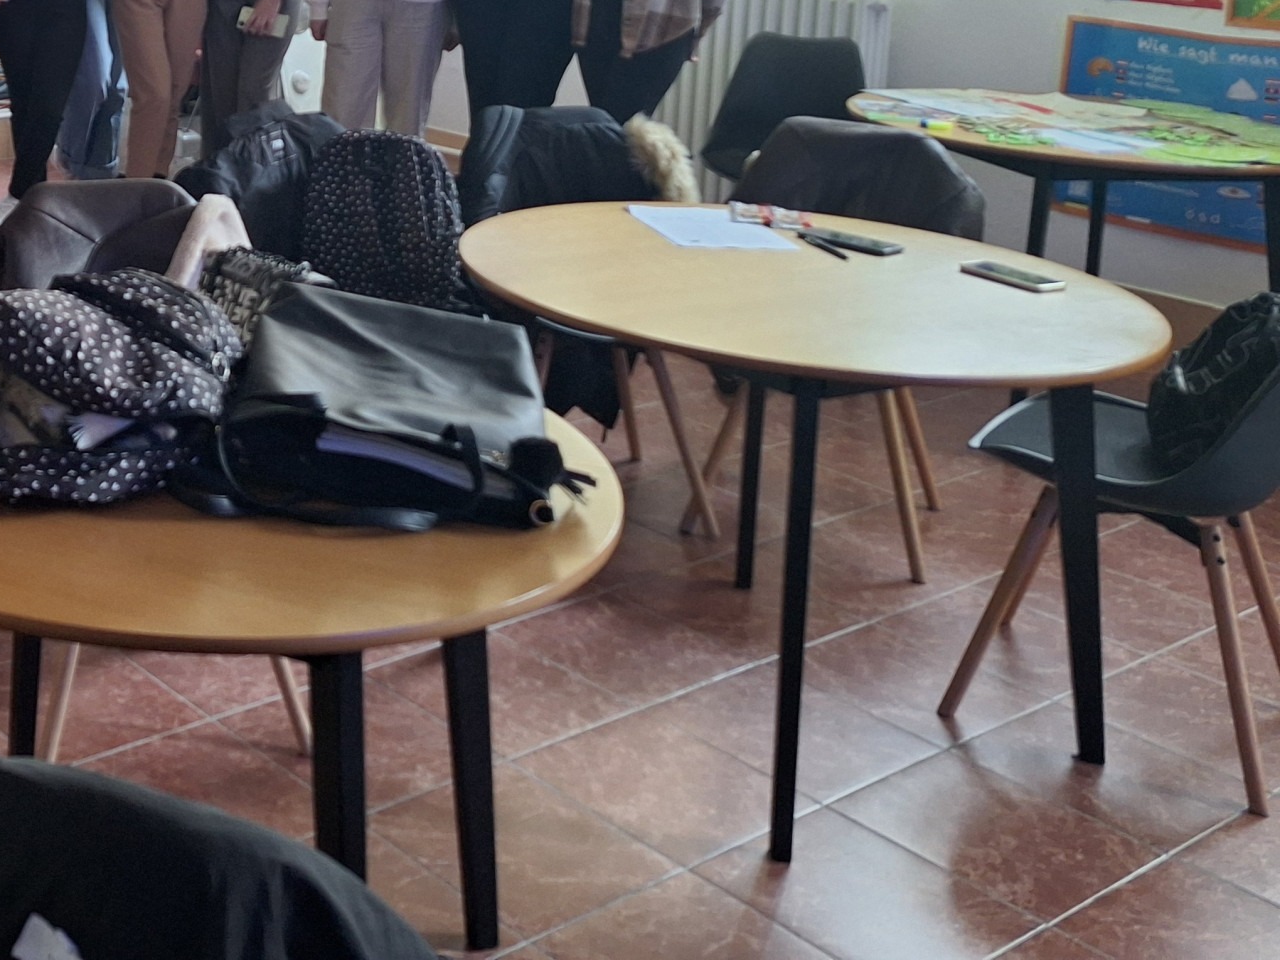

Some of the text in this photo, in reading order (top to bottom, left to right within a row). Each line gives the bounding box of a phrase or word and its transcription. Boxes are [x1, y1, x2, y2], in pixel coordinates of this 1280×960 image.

[1137, 35, 1279, 66] Wie sagt man
